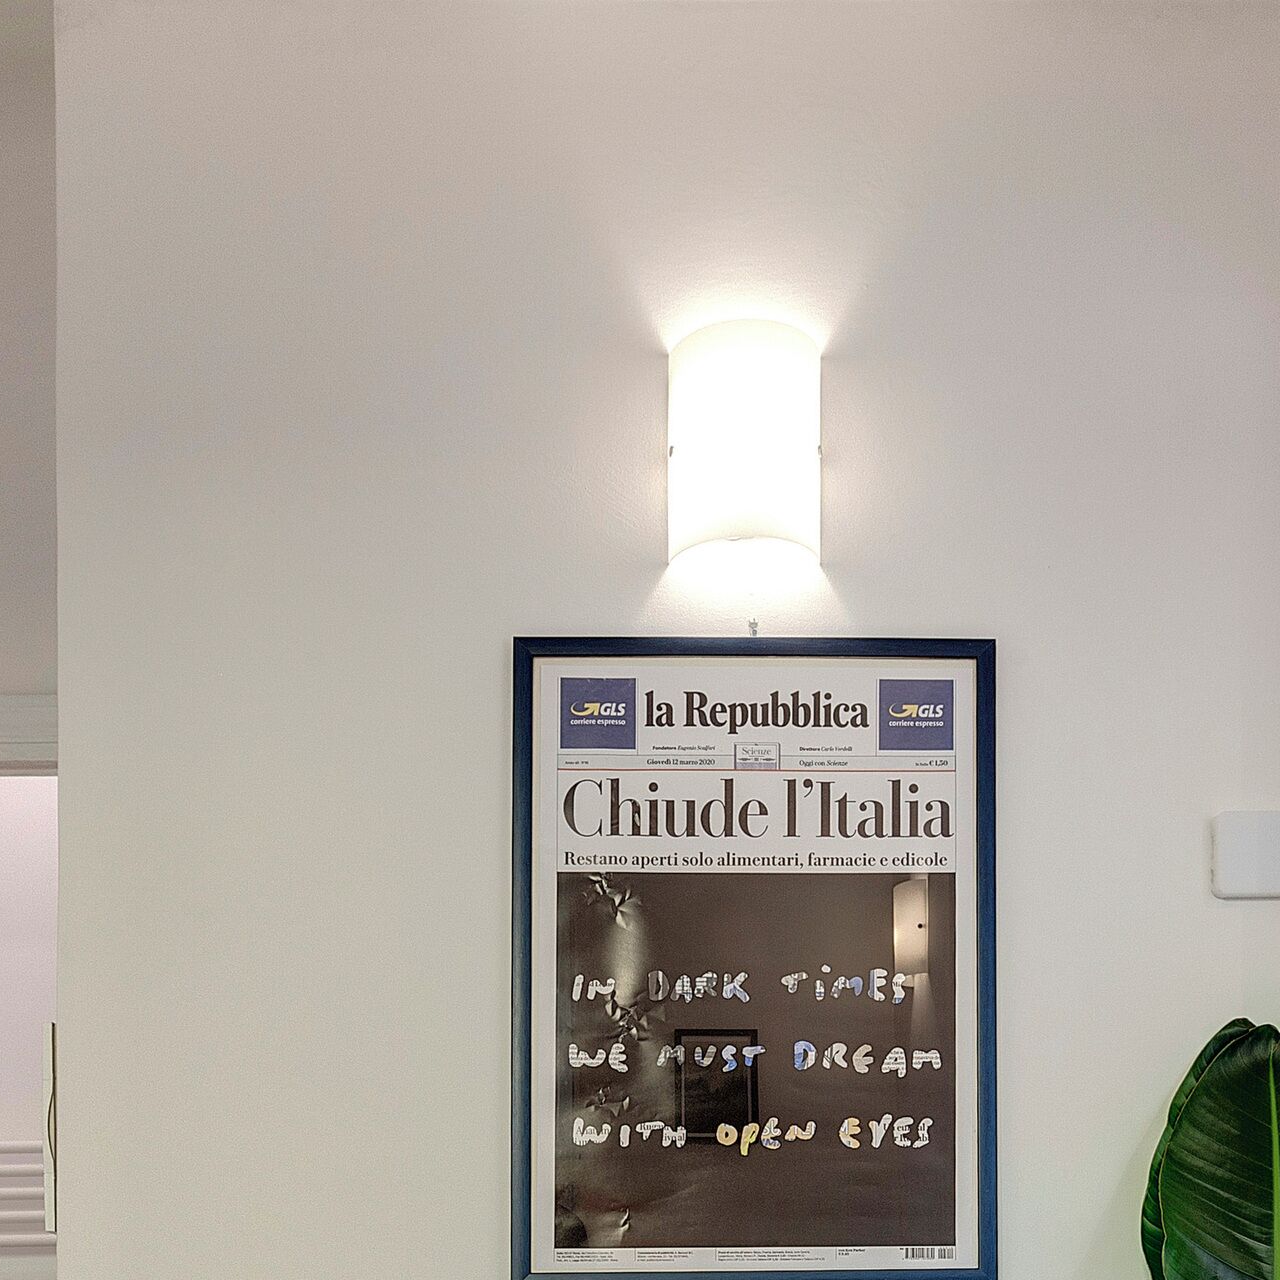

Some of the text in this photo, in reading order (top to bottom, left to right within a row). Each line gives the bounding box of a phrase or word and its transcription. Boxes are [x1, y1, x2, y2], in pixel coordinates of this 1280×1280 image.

[570, 717, 626, 727] corriere espresso
[599, 702, 626, 716] GLS
[644, 690, 870, 735] la Repubblica
[917, 704, 944, 718] GLS
[888, 719, 944, 728] corriere espresso
[563, 778, 769, 838] Chiude
[564, 851, 948, 869] Restano aperti solo alimentari, farmacie e edicole
[572, 973, 616, 1002] IN
[647, 970, 751, 1004] DARK
[568, 1040, 942, 1078] WE MUST DREAM
[572, 1116, 687, 1148] WITH
[838, 1113, 934, 1149] EYES
